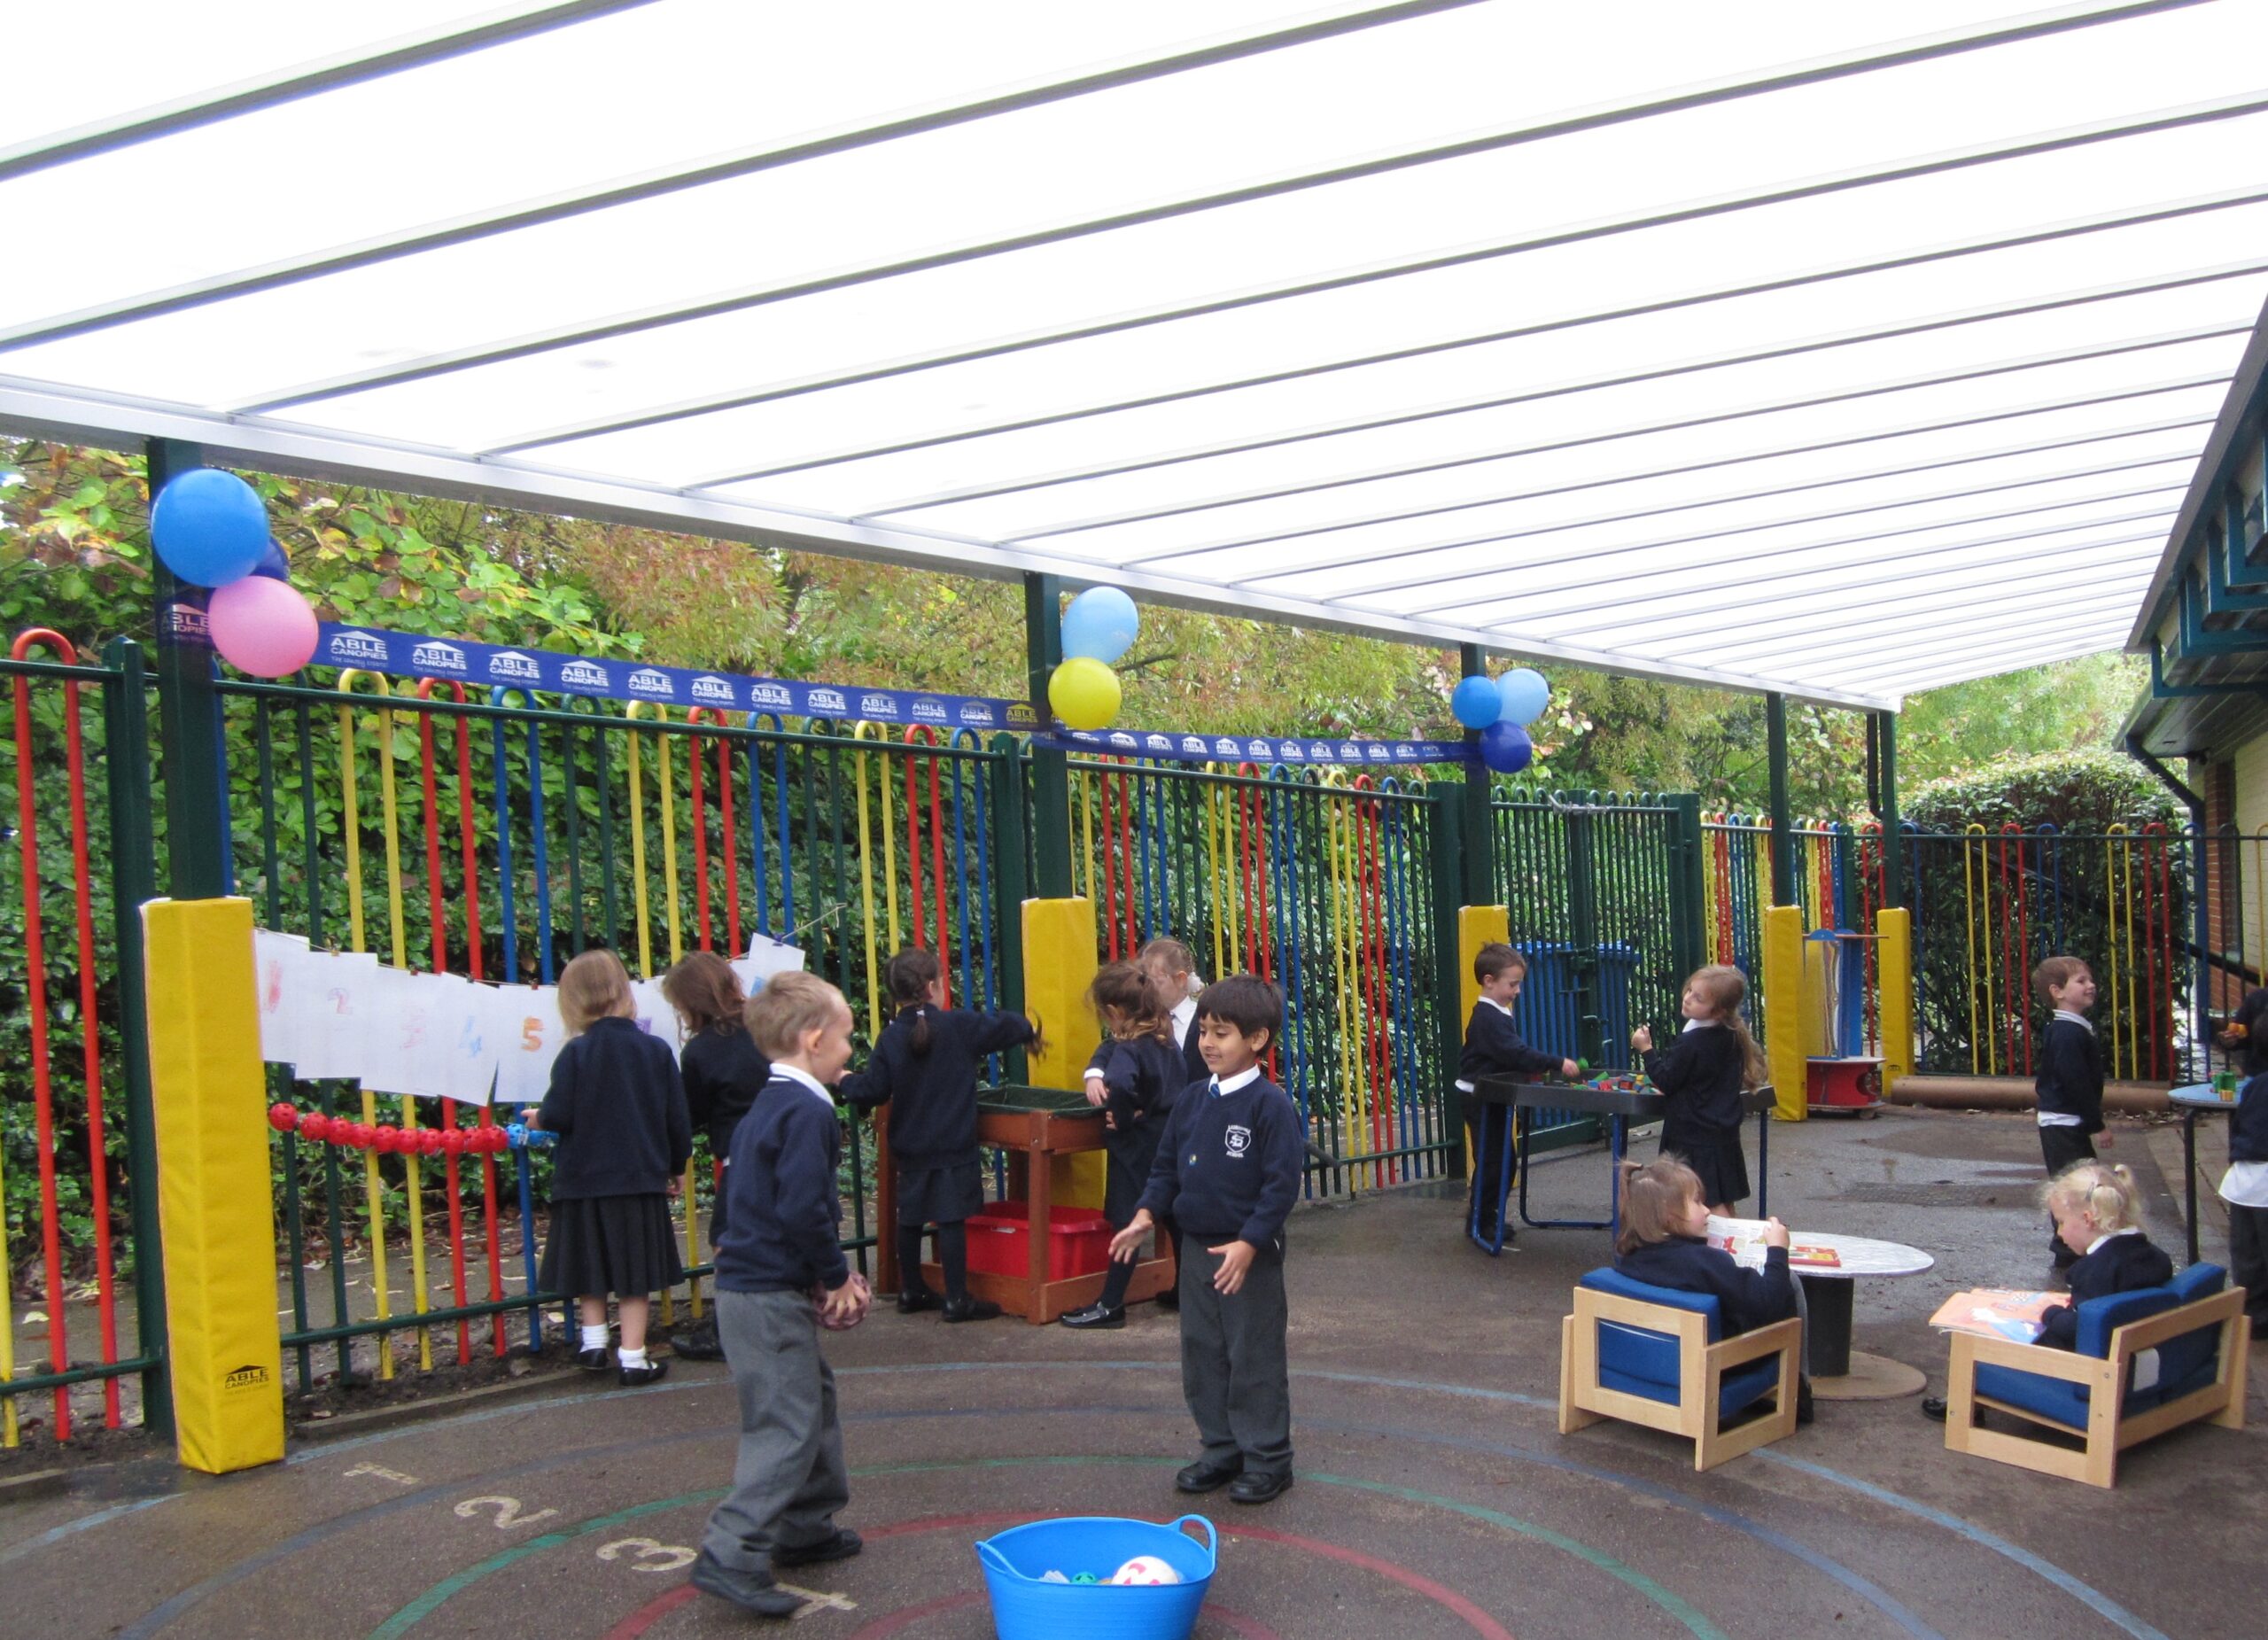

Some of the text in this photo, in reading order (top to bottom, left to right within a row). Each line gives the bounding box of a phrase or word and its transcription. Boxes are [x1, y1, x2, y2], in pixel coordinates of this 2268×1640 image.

[330, 637, 387, 653] ABLE
[330, 647, 388, 660] CANOPIES
[413, 648, 465, 663] ABLE
[413, 657, 467, 670] CANOPIES
[489, 657, 539, 672] ABLE
[489, 666, 540, 679] CANOPIES
[561, 666, 608, 680] ABLE
[561, 675, 609, 687] CANOPIES
[628, 674, 672, 687] ABLE
[692, 681, 733, 693] ABLE
[751, 688, 790, 698] ABLE
[808, 694, 844, 703] ABLE
[861, 698, 897, 708] ABLE
[912, 703, 945, 711] ABLE
[959, 707, 991, 717] ABLE
[1006, 709, 1036, 718] ABLE
[1248, 744, 1270, 753] ABLE
[521, 1015, 545, 1052] 5
[225, 1369, 268, 1382] ABLE
[224, 1377, 269, 1389] CANOPIES
[454, 1496, 559, 1529] 2
[596, 1537, 697, 1572] 3
